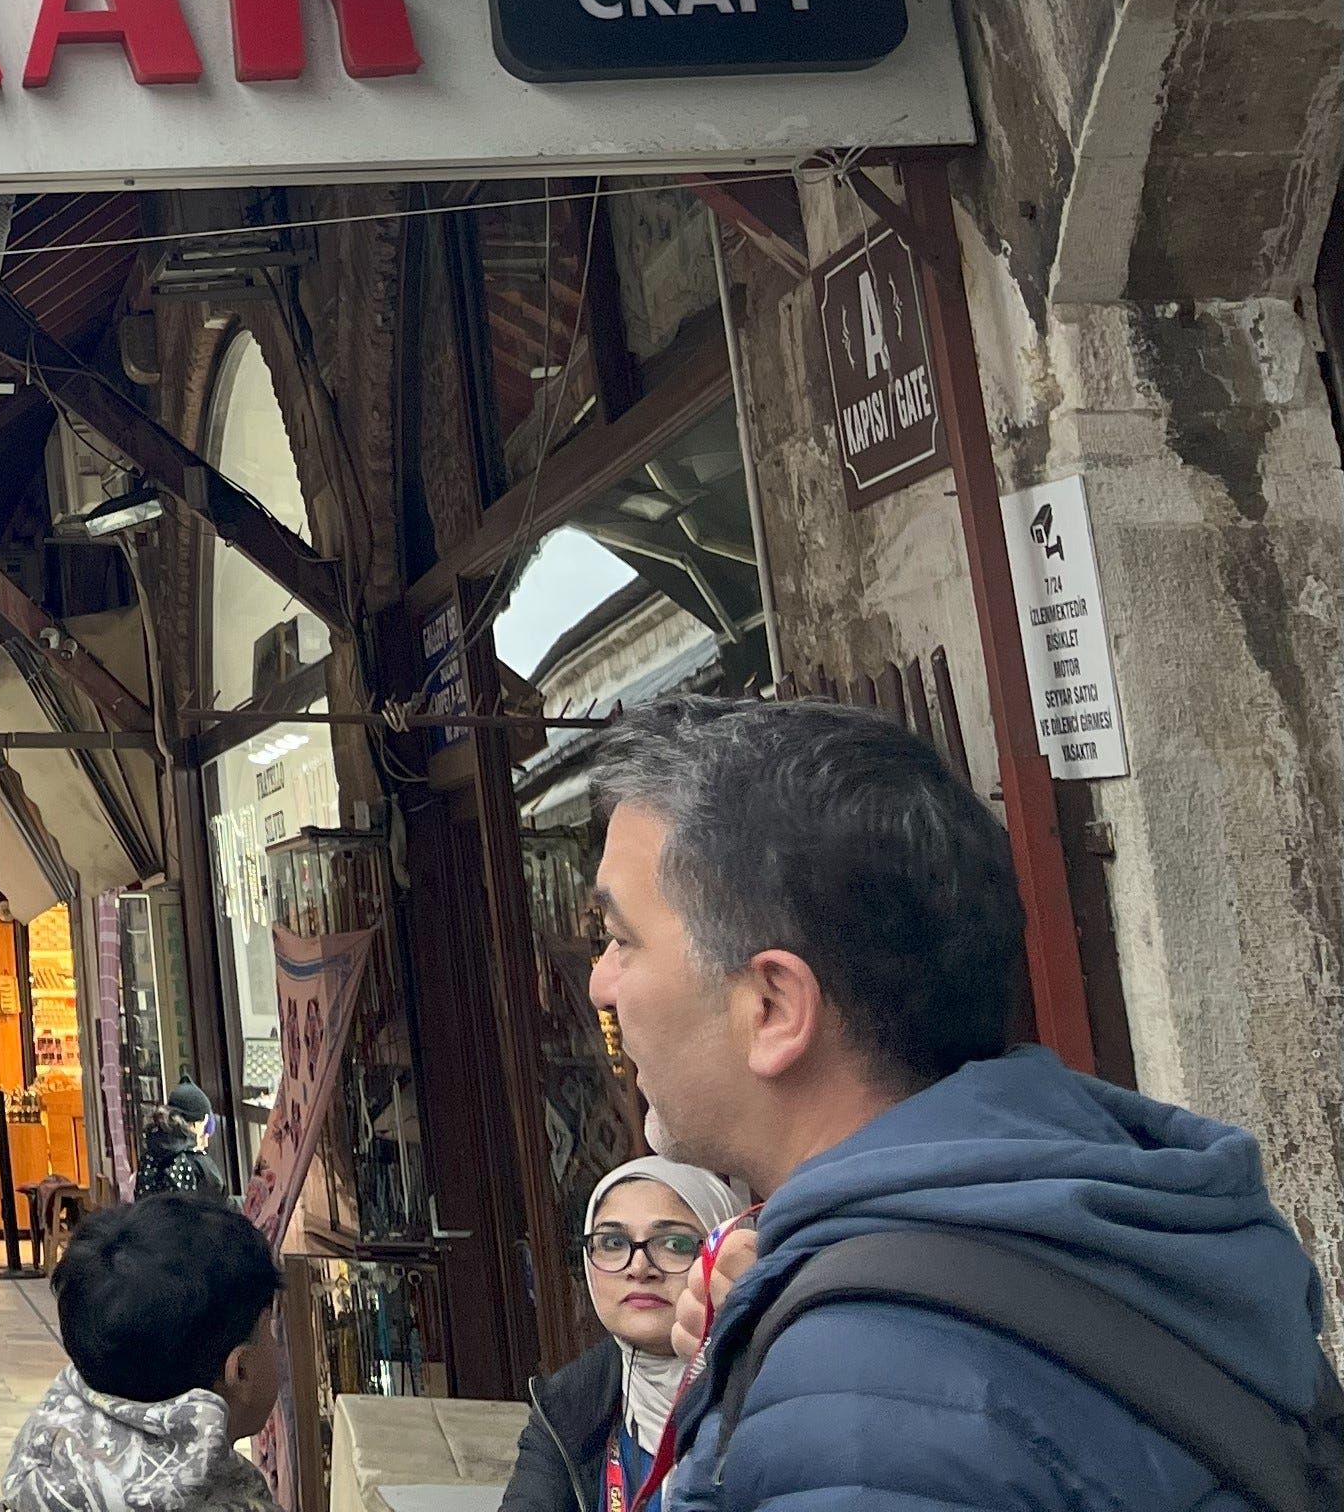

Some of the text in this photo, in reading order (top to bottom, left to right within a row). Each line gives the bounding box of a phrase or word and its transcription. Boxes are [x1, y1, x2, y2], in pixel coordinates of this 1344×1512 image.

[859, 271, 891, 379] A
[843, 390, 889, 456] KAPISI
[895, 365, 932, 429] GATE
[1044, 576, 1063, 596] 7/24
[1053, 657, 1081, 679] MOTOR
[1045, 687, 1073, 708] SEYYAR
[1040, 718, 1051, 736] VE
[1061, 742, 1097, 762] YASAKTIR
